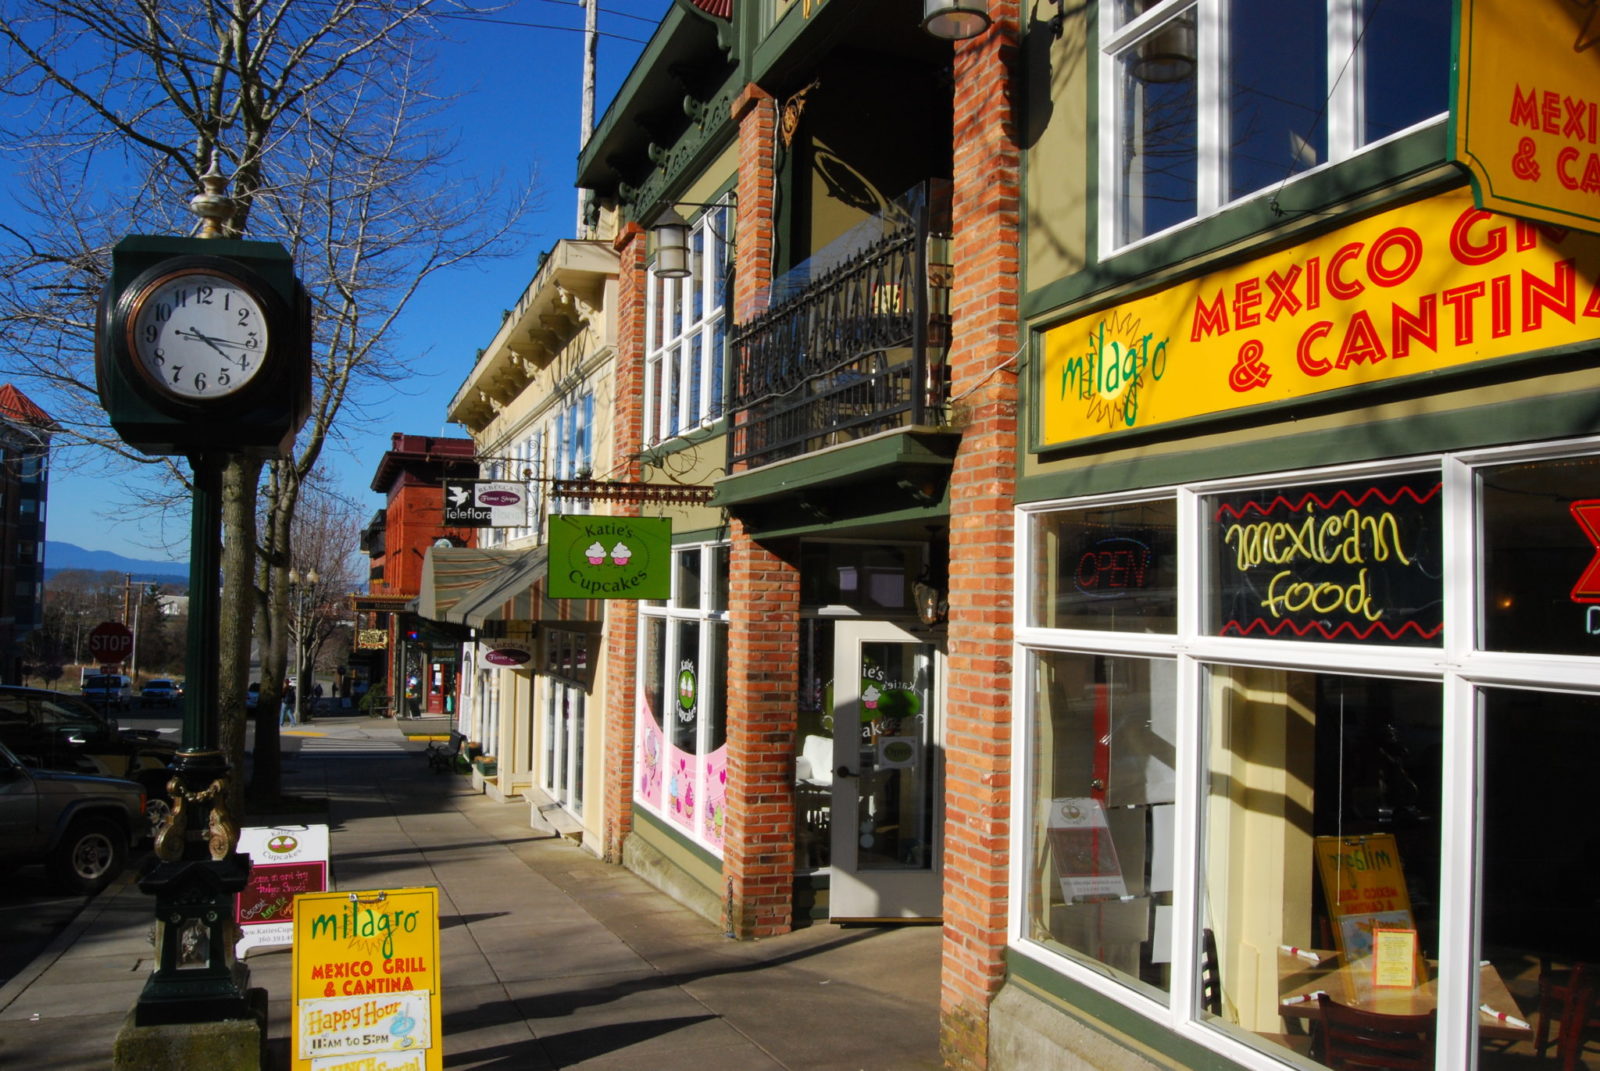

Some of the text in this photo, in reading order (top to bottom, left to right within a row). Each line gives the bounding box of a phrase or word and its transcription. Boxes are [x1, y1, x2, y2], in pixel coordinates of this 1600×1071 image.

[1509, 82, 1598, 145] MEXI
[1511, 136, 1541, 183] &
[1190, 227, 1423, 342] MEXICO
[175, 289, 187, 308] 11
[196, 286, 214, 305] 12
[224, 292, 230, 311] 1
[155, 303, 172, 322] 10
[237, 308, 250, 327] 2
[146, 325, 157, 343] 9
[245, 332, 258, 349] 3
[153, 348, 165, 366] 8
[236, 353, 250, 371] 4
[1228, 339, 1272, 394] &
[172, 365, 184, 383] 7
[194, 372, 206, 391] 6
[217, 367, 231, 386] 5
[1061, 320, 1169, 426] milagro
[446, 507, 492, 520] Teleflora
[585, 524, 634, 539] Katie's
[1226, 502, 1411, 572] mexican
[1078, 550, 1147, 587] OPEN
[568, 568, 648, 595] Cupcakes
[1261, 568, 1383, 622] food
[91, 634, 131, 650] STOP
[312, 901, 419, 959] milagro
[311, 956, 426, 980] MEXICO GRILL
[323, 976, 414, 997] & CANTINA
[307, 1000, 402, 1035] Happy Hour
[345, 1036, 360, 1046] to
